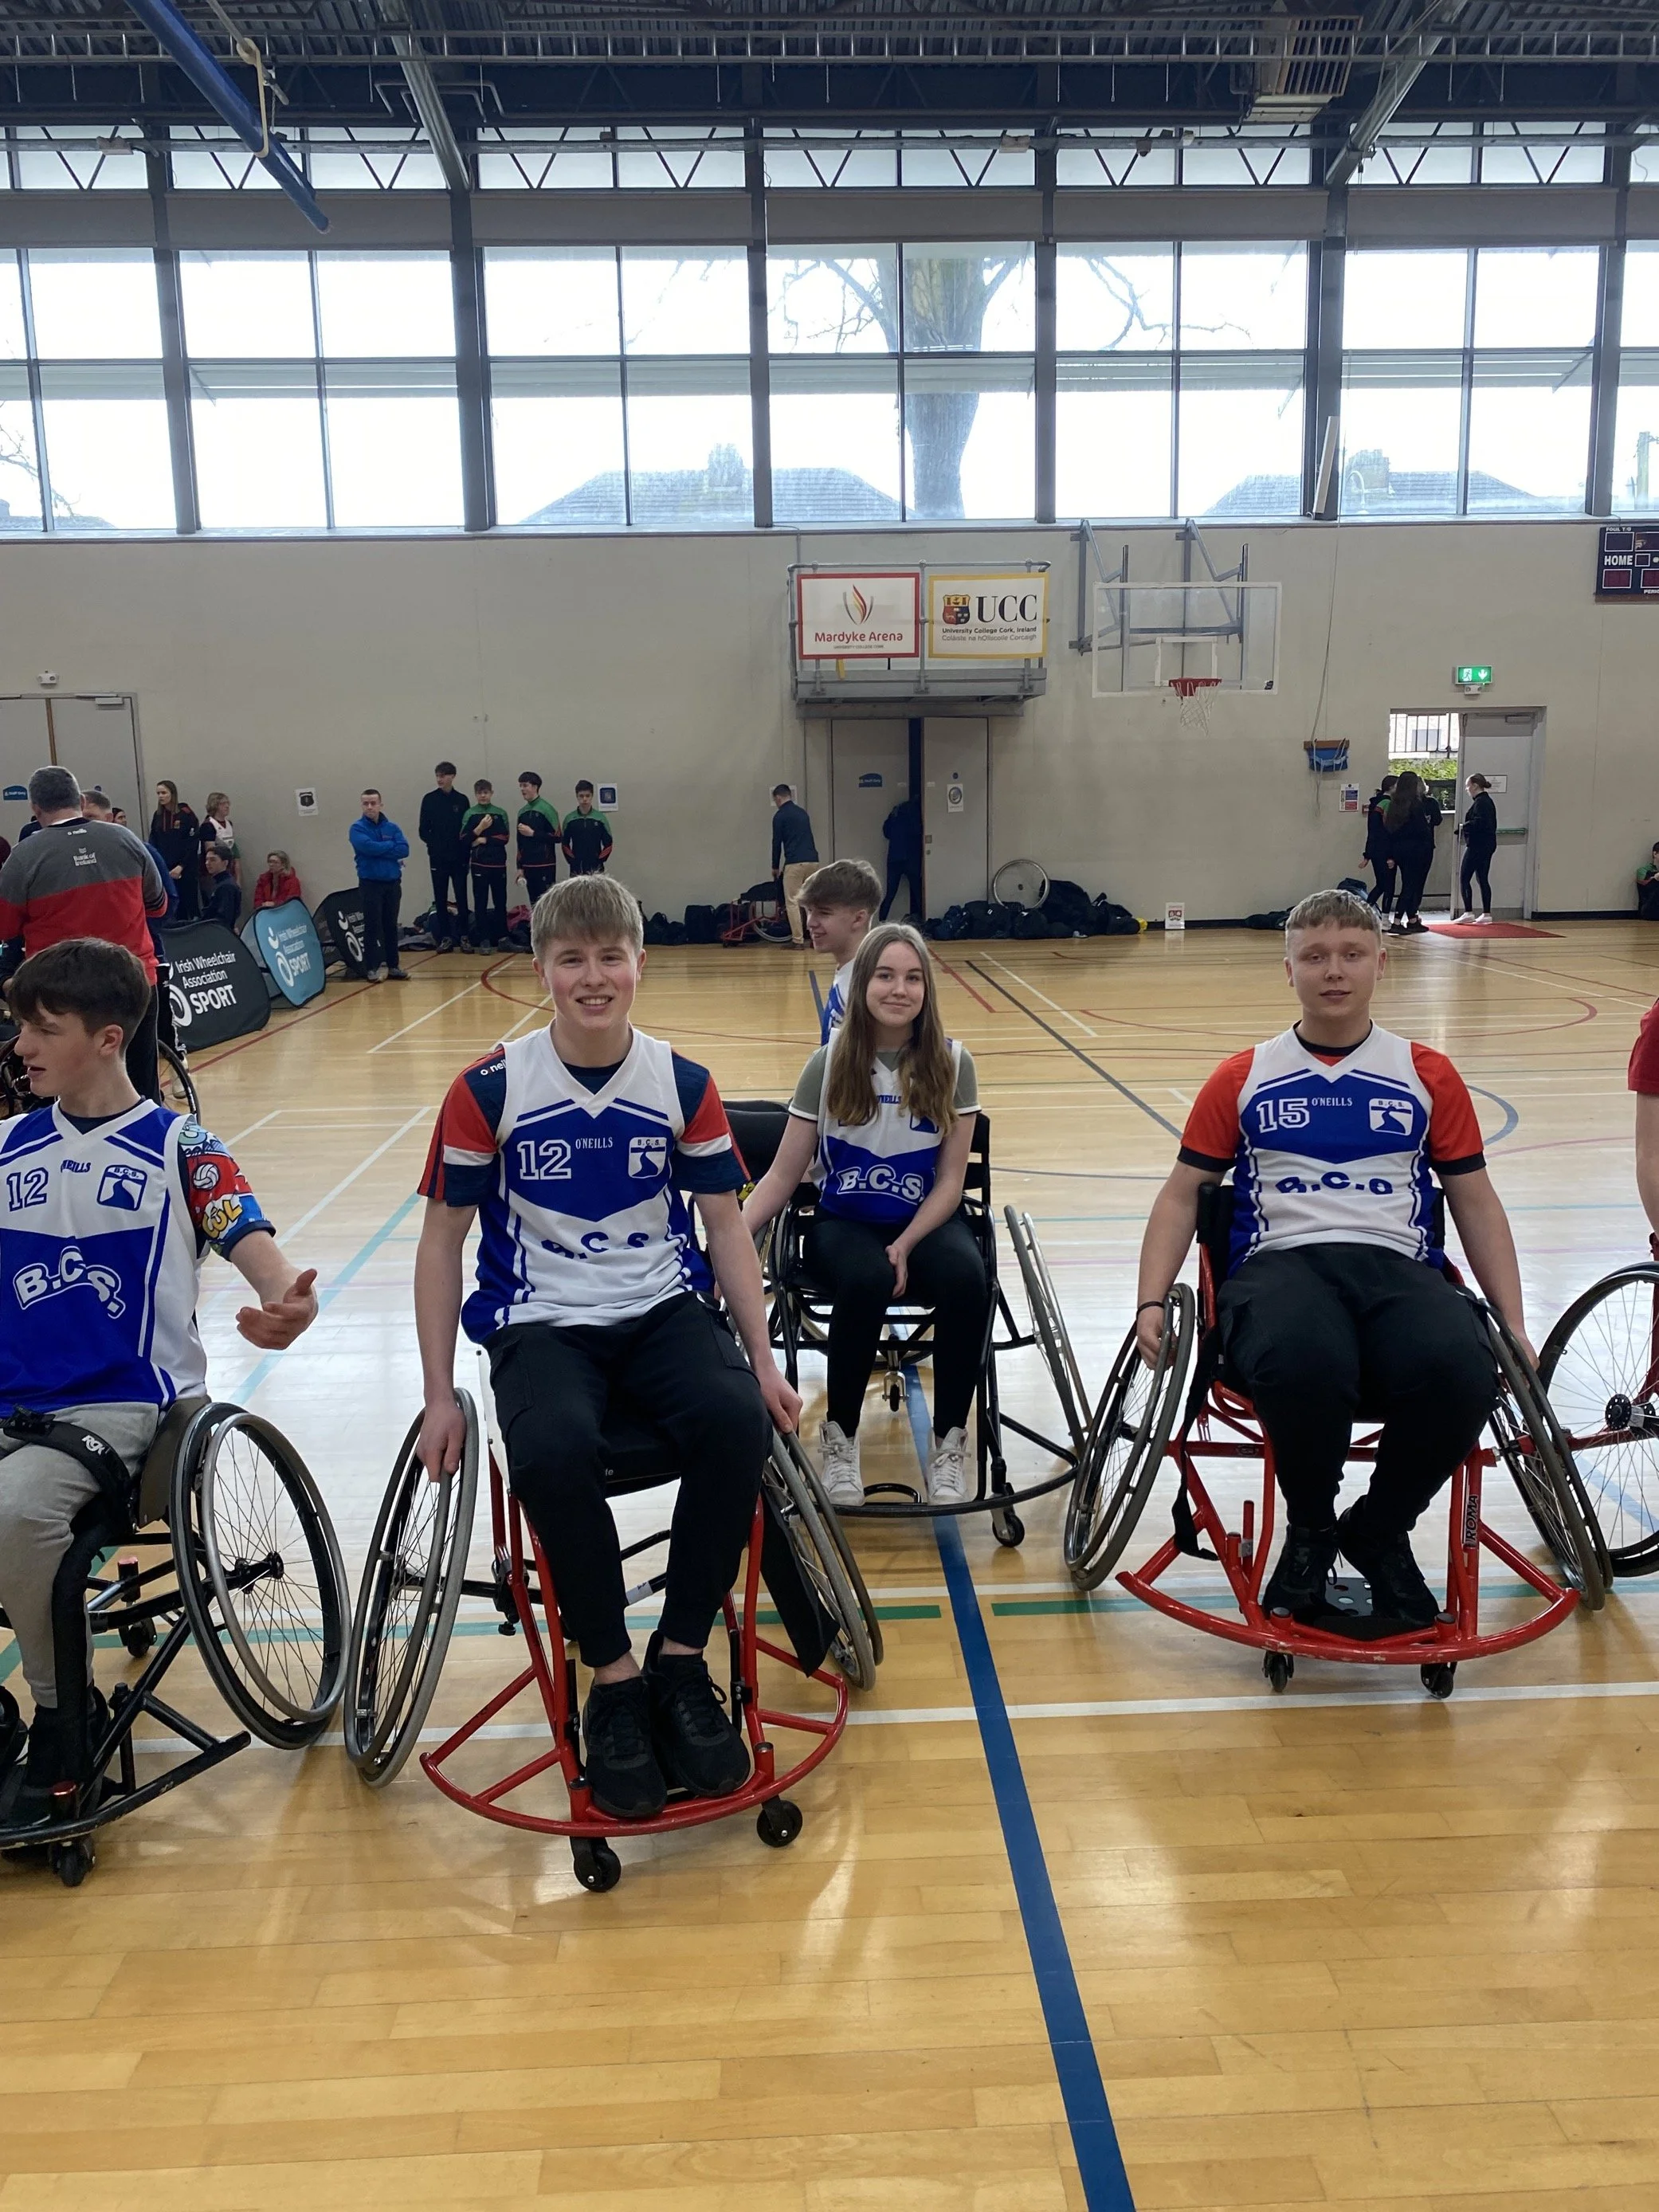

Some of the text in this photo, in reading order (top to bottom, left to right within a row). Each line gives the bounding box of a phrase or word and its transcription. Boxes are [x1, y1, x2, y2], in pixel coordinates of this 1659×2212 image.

[1604, 555, 1634, 566] HOME
[976, 594, 1037, 623] UCC
[814, 631, 903, 644] Mardyke Arena
[175, 951, 237, 974] Irish Wheelchair
[288, 951, 312, 977] SPORT
[182, 969, 229, 989] Association
[190, 984, 237, 1014] SPORT
[1312, 1096, 1353, 1108] O'NEILLS
[1256, 1097, 1310, 1133] 15
[575, 1136, 614, 1151] O'NEILLS
[516, 1139, 572, 1181] 12
[114, 1167, 139, 1179] B.C.S.
[6, 1167, 49, 1212] 12
[1466, 1495, 1478, 1540] ROMA
